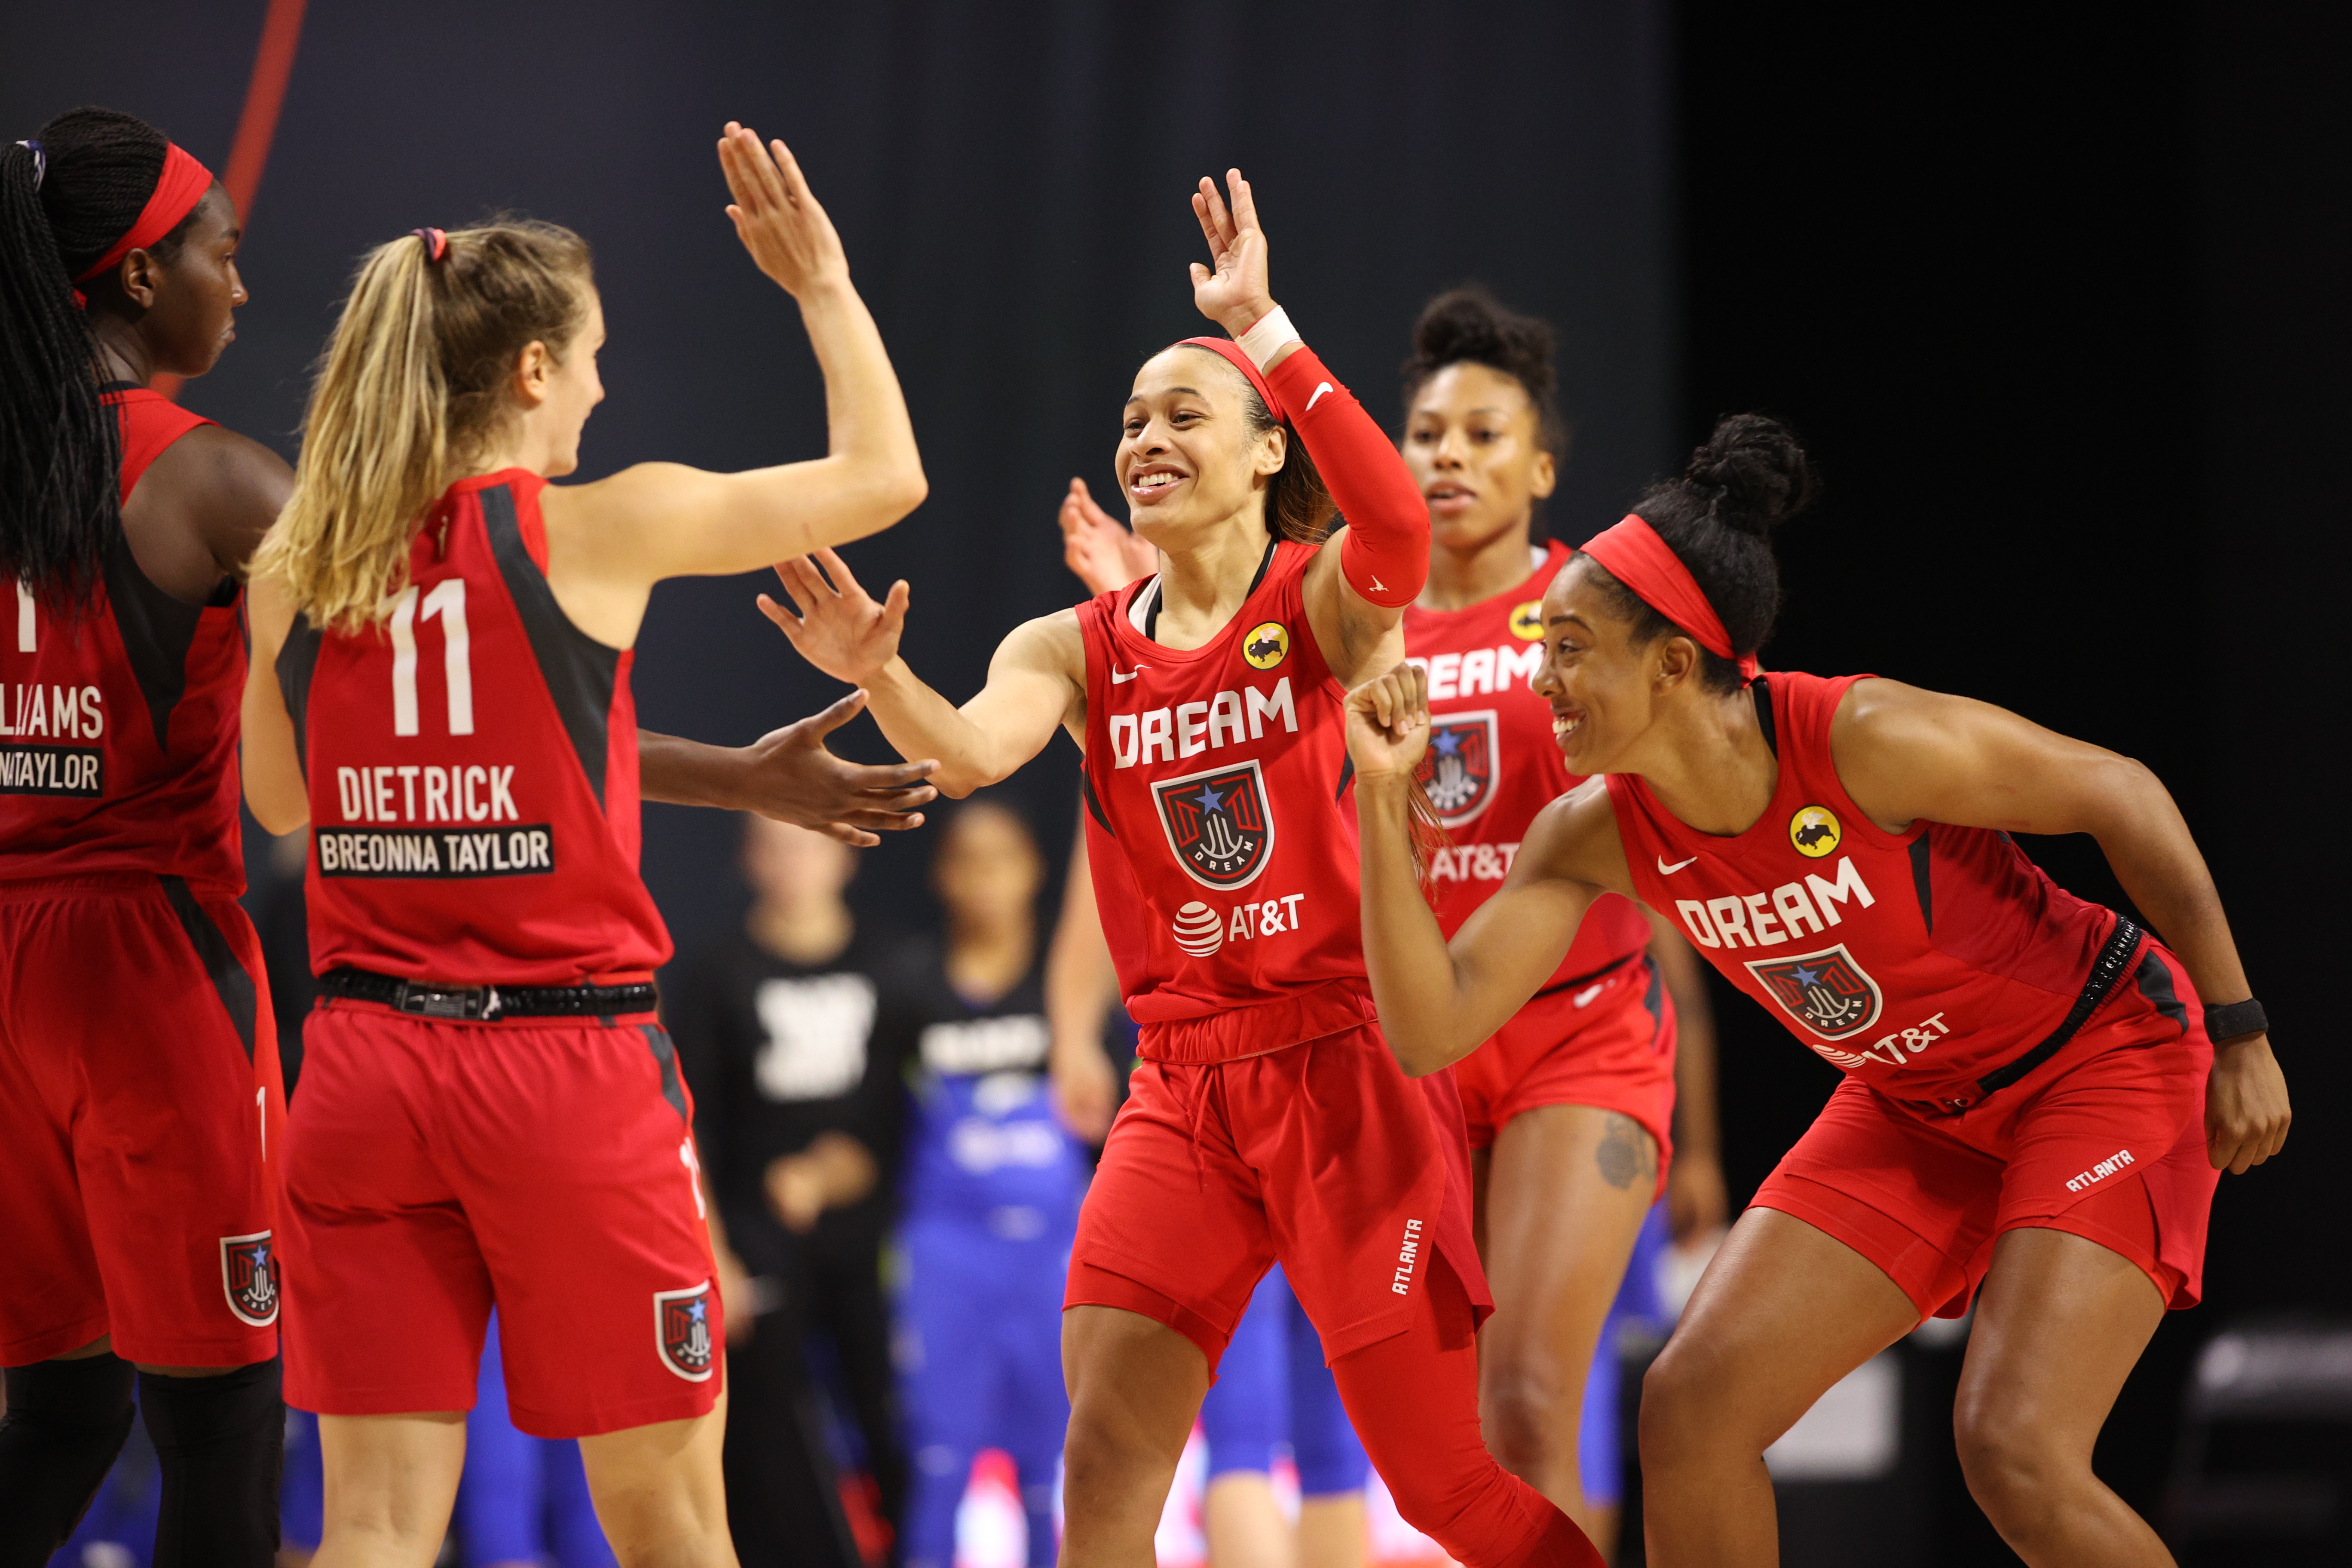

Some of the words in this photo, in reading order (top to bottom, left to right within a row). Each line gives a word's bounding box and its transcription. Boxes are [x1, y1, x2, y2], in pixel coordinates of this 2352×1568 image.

[377, 578, 474, 736] 11
[1405, 642, 1547, 701] EAM
[1109, 677, 1298, 769] DREAM
[337, 765, 519, 821] DIETRICK
[320, 833, 440, 872] BREONNA
[444, 830, 551, 872] TAYLOR
[1194, 841, 1254, 871] DREAM
[1430, 842, 1521, 882] AT&T
[1229, 893, 1305, 942] AT&T
[1675, 855, 1876, 949] DREAM
[1805, 1001, 1862, 1027] DREAM
[256, 1086, 266, 1162] 1
[2065, 1149, 2135, 1192] ATLANTA
[1391, 1219, 1423, 1295] ATLANTA
